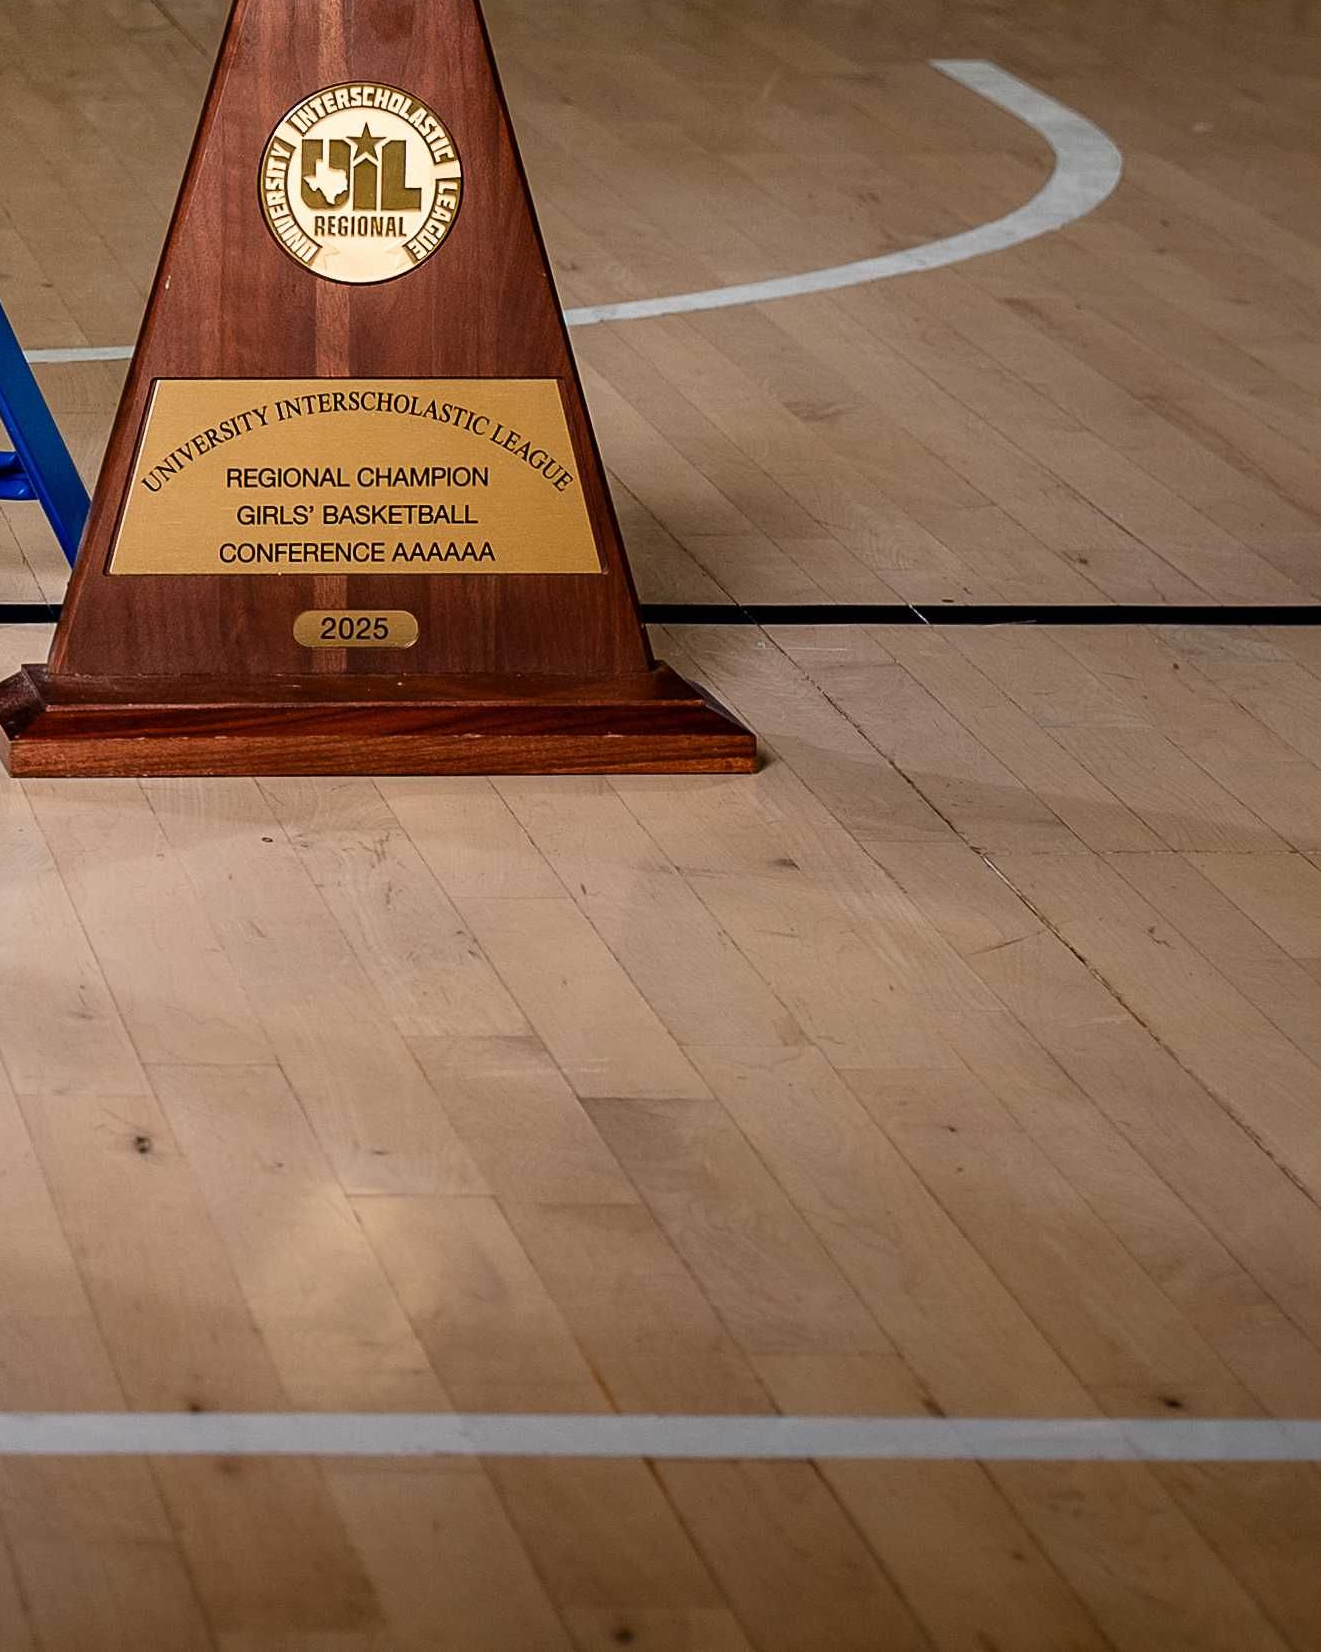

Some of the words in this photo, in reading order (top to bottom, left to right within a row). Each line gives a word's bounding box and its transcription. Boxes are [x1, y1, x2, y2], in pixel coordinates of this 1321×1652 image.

[288, 86, 455, 163] INTERSCHOLASTIC
[301, 138, 422, 211] UIL
[265, 141, 319, 262] UNIVERSITY
[406, 182, 458, 260] LEAGUE
[314, 216, 407, 237] REGIONAL
[141, 405, 269, 494] UNIVERSITY
[274, 391, 490, 436] INTERSCHOLASTIC
[489, 422, 574, 493] LEAGUE
[226, 467, 350, 488] REGIONAL
[357, 467, 489, 487] CHAMPION
[323, 505, 478, 524] BASKETBALL
[219, 542, 385, 563] CONFERENCE
[392, 542, 495, 562] AAAAAA
[320, 617, 388, 640] 2025
